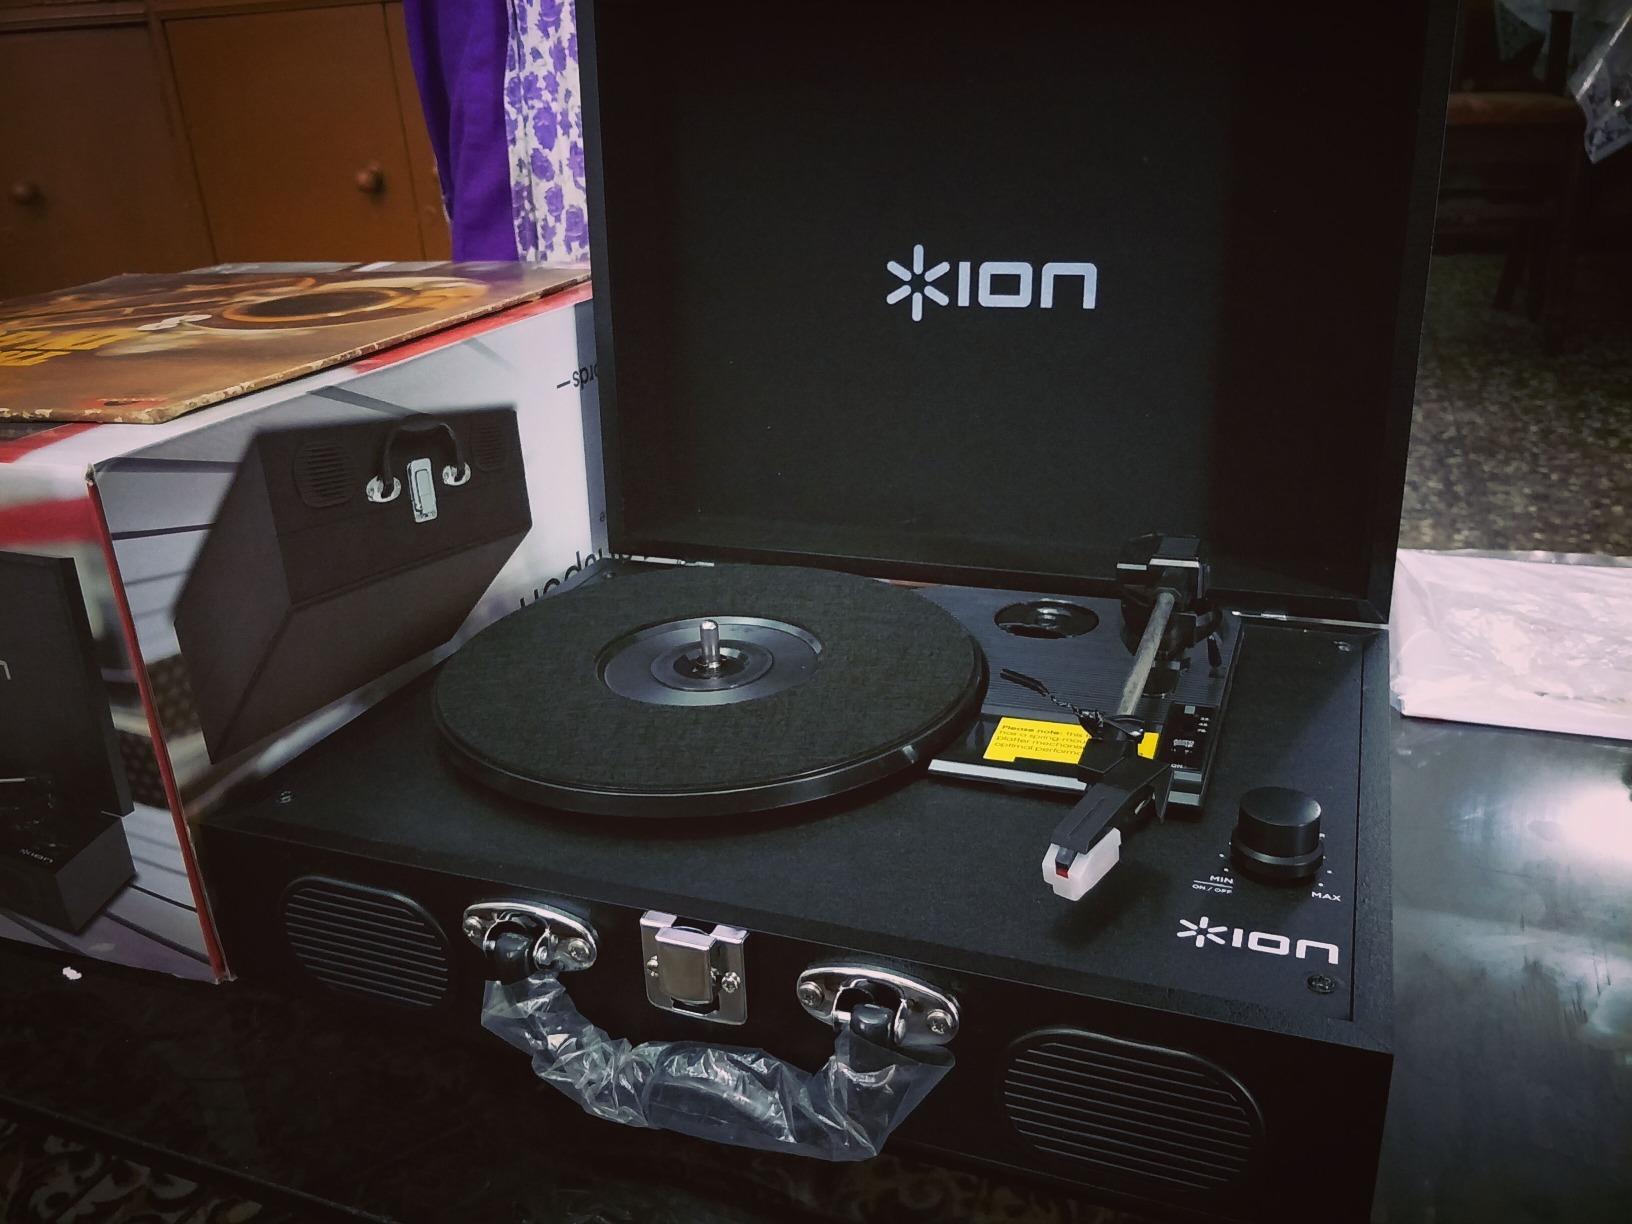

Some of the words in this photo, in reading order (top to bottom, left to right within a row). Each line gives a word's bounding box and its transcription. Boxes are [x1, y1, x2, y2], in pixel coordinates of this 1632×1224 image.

[957, 261, 1098, 309] ION
[1209, 875, 1234, 884] MIN
[1311, 891, 1342, 902] MAX
[1231, 928, 1339, 965] ION
